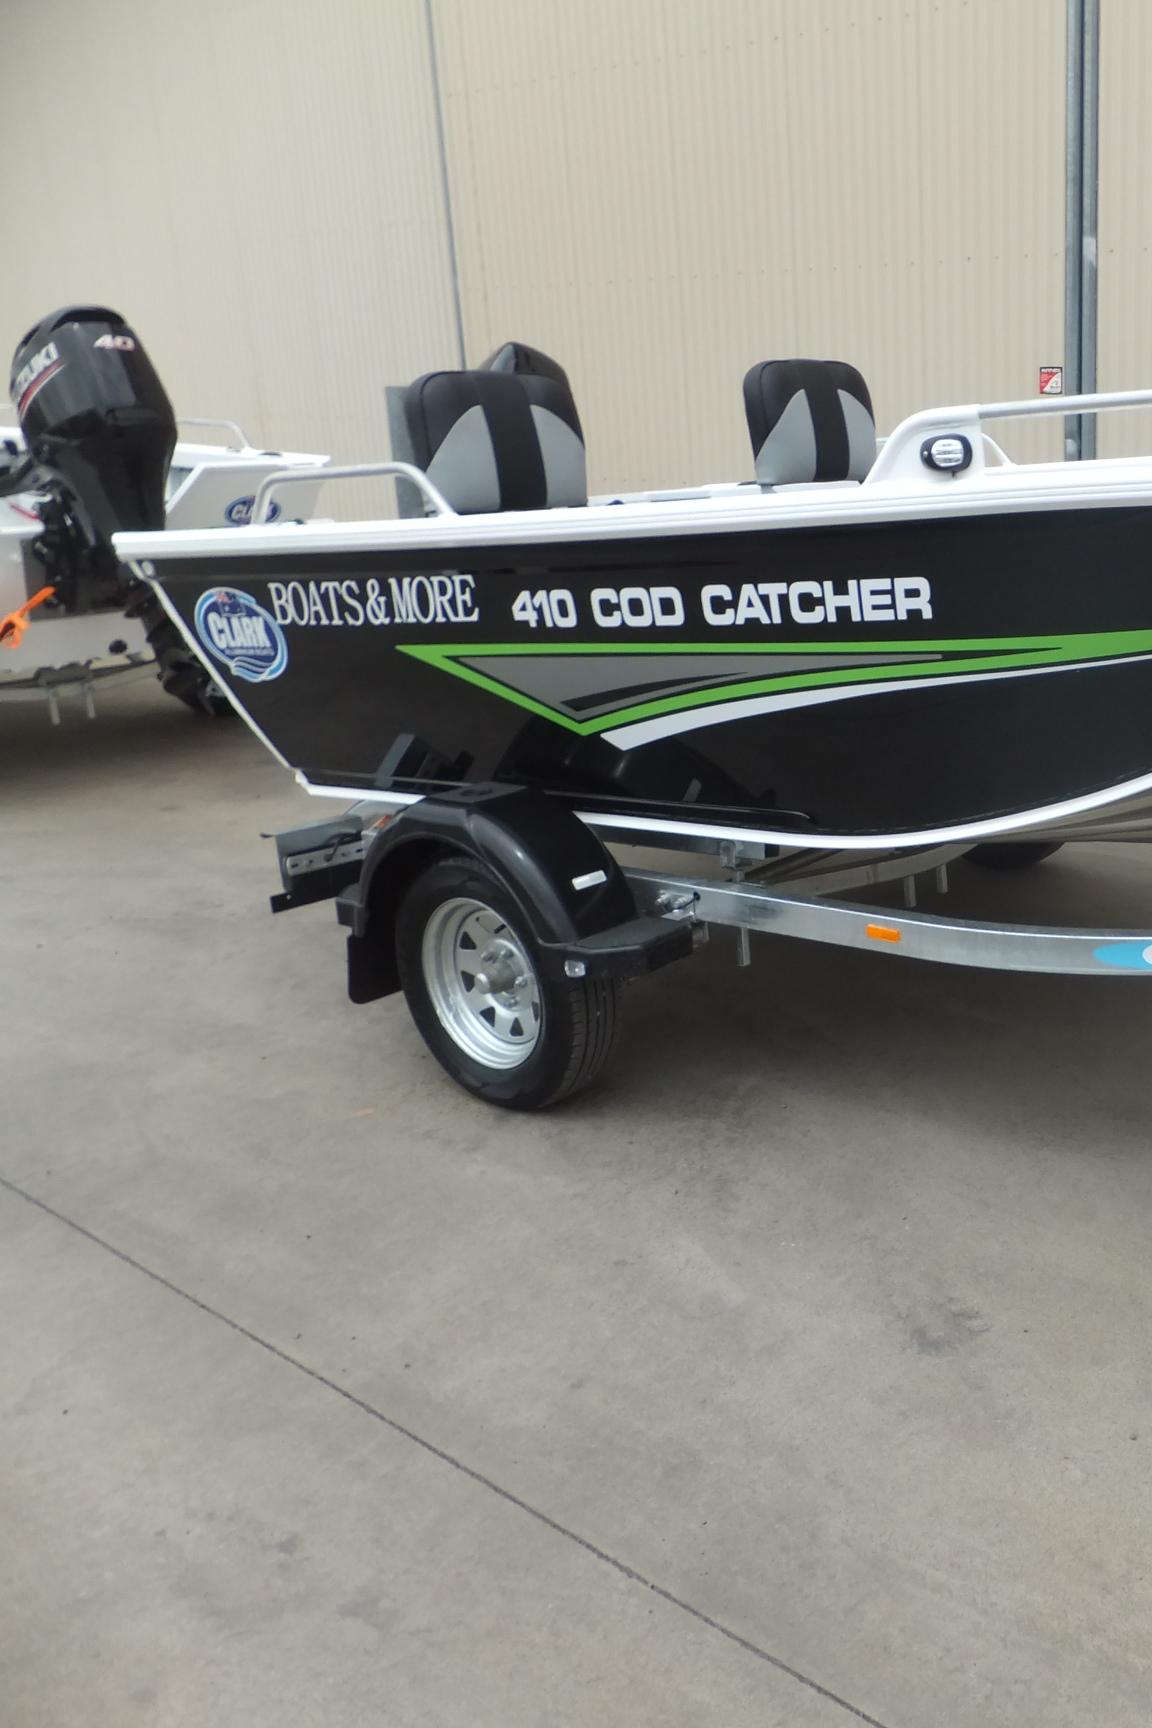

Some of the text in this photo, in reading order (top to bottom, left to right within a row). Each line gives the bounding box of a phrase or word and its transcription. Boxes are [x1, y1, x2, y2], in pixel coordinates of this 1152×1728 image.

[93, 334, 135, 351] 40
[511, 576, 932, 628] 410 COD CATCHER
[207, 611, 272, 650] CLARK
